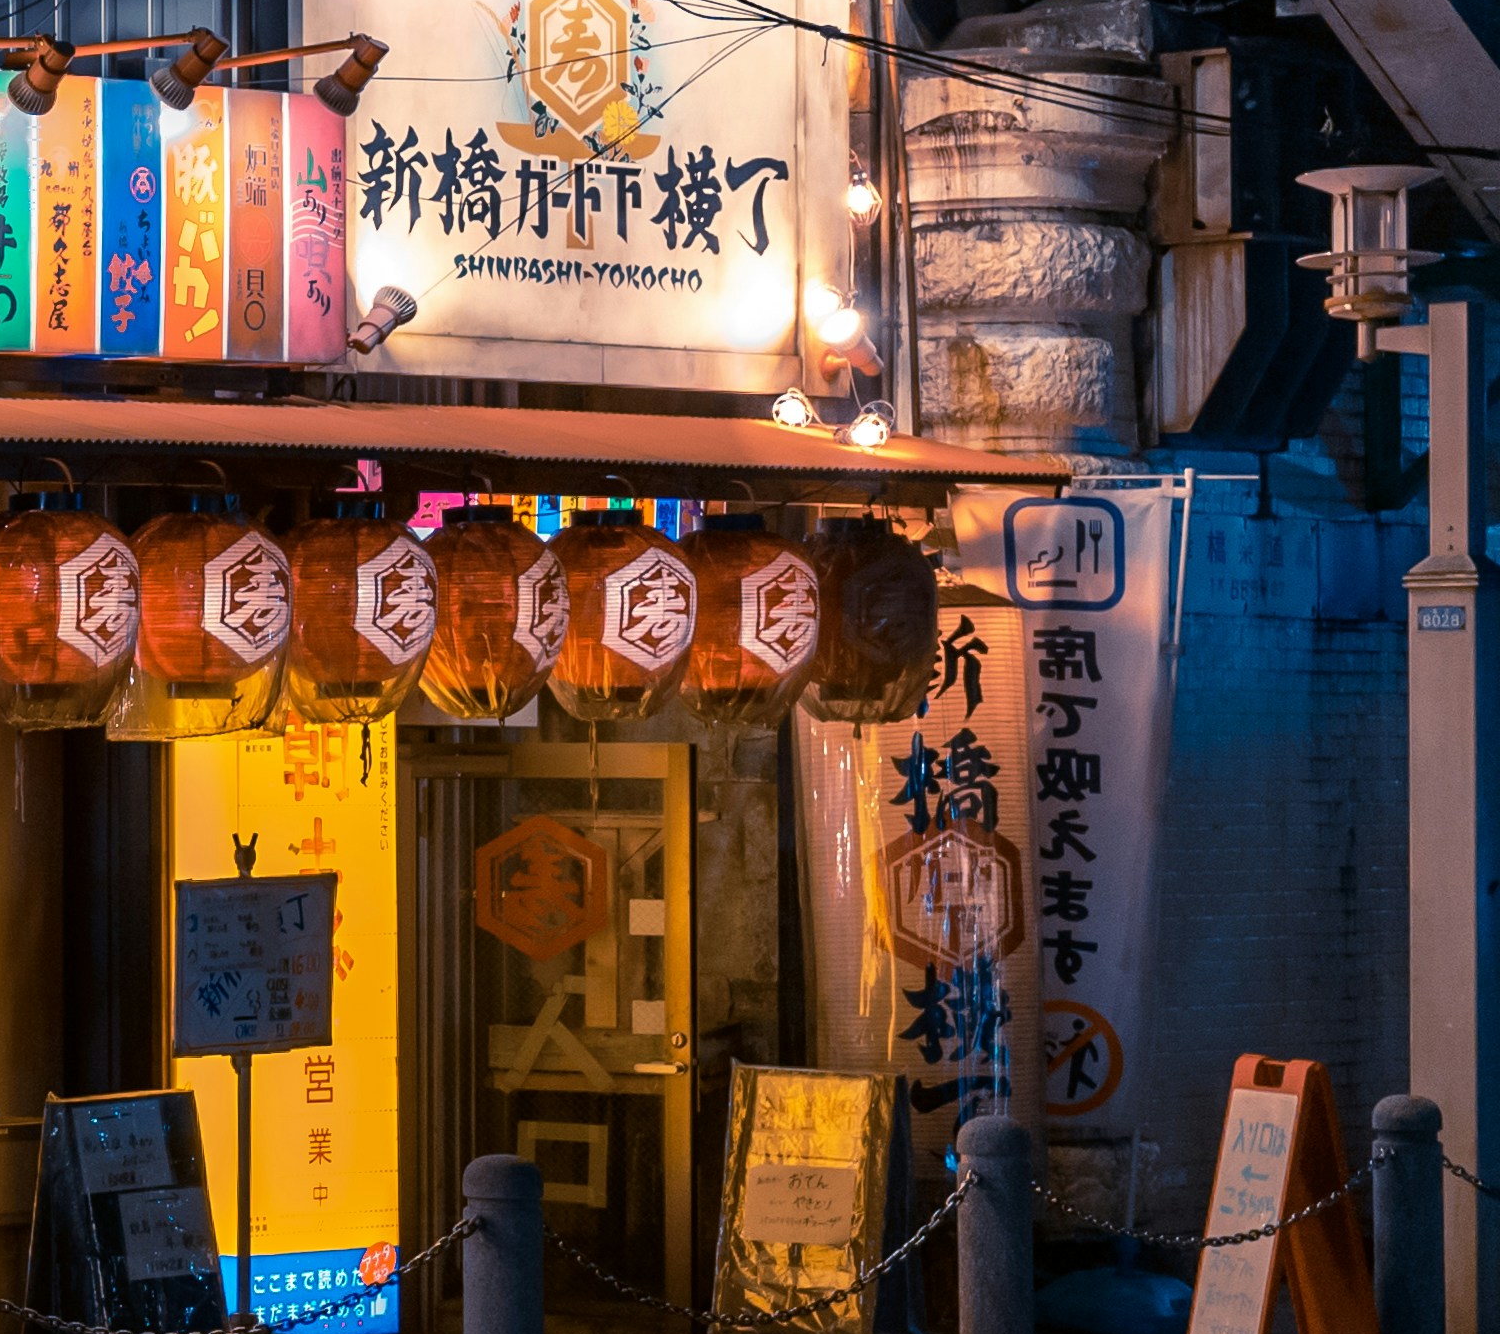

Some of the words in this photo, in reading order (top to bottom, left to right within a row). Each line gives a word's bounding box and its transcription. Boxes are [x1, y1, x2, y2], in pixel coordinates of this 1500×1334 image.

[296, 146, 329, 227] 山あり
[356, 118, 790, 257] 新橋ガード下横丁
[46, 201, 73, 333] 都久志屋
[453, 253, 704, 294] SHINBASHI-YOKOCHO
[1421, 613, 1461, 629] 8028
[1031, 624, 1104, 986] 席で吸えます
